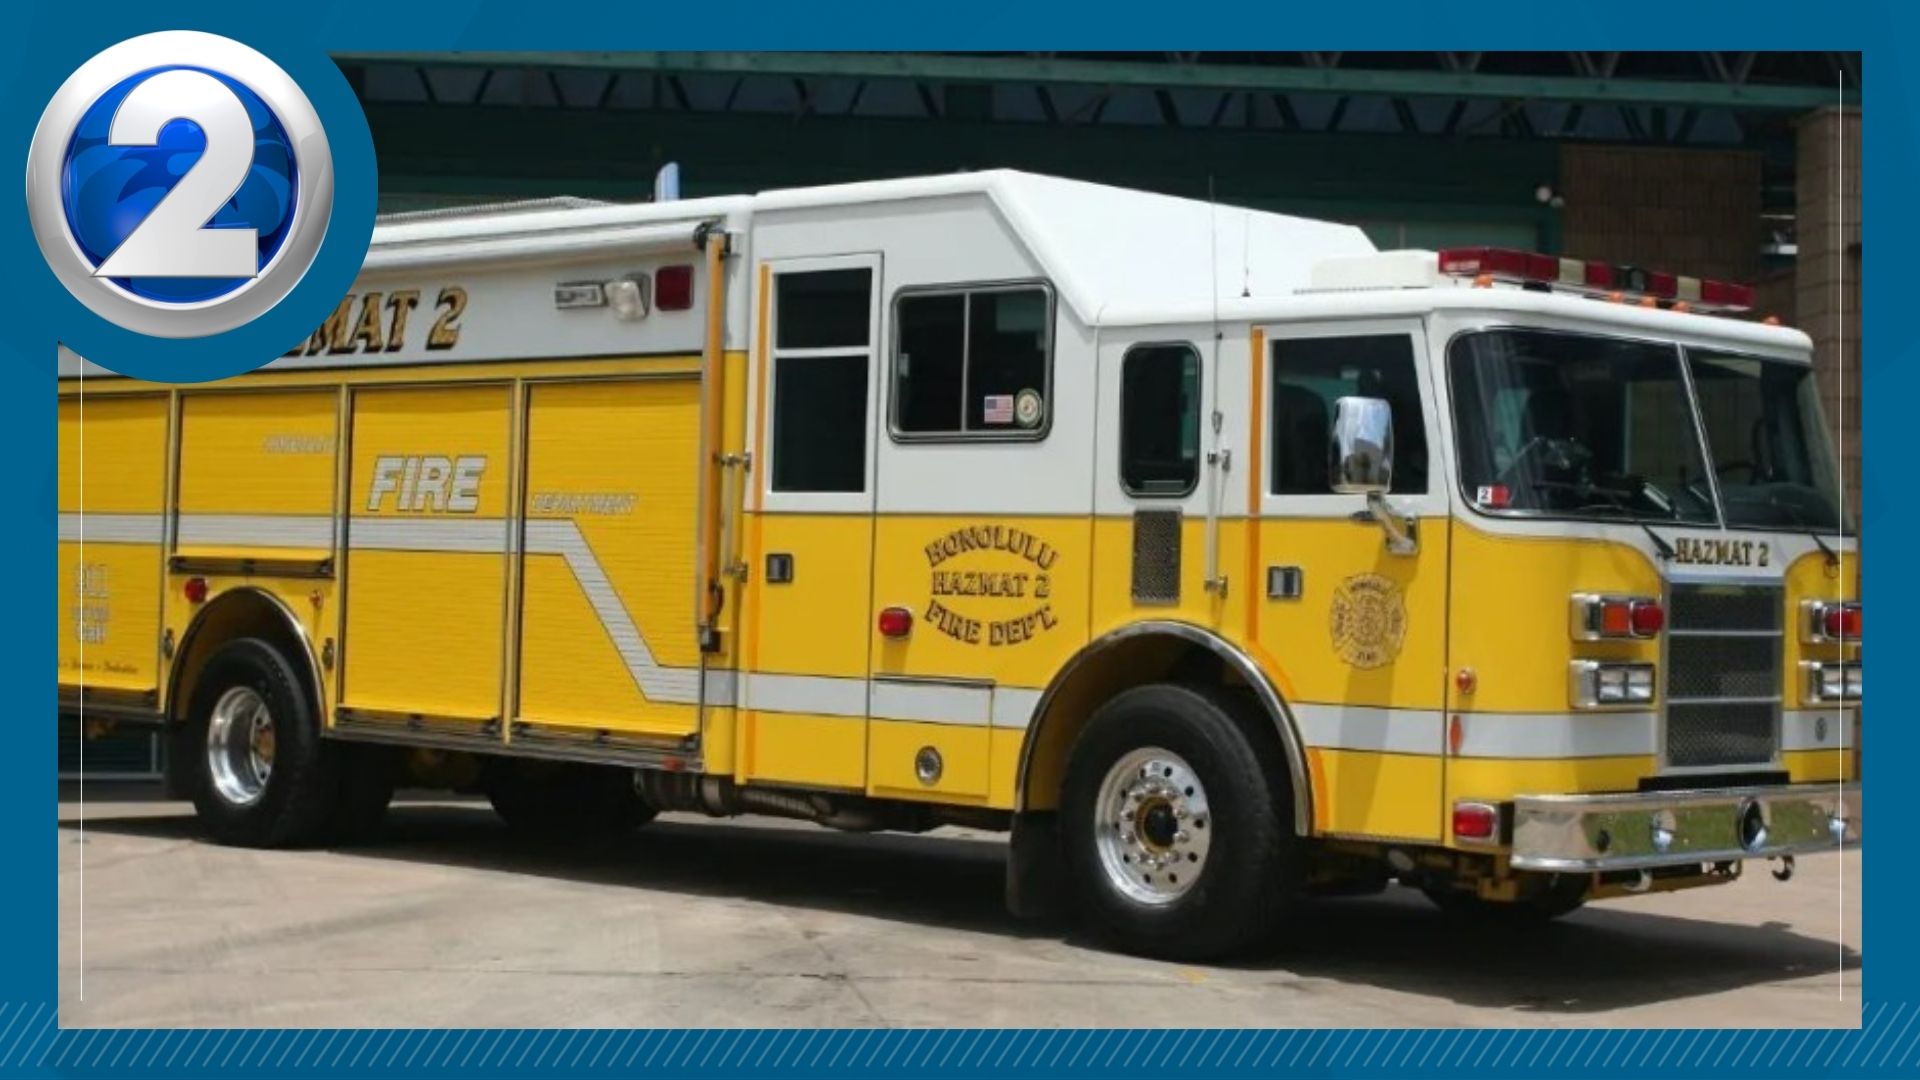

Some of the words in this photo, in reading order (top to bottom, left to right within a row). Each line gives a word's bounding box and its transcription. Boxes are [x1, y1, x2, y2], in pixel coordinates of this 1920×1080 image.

[281, 289, 420, 357] MAT
[426, 285, 468, 350] 2
[366, 455, 487, 512] FIRE
[924, 525, 1058, 570] HONOLULU
[1676, 537, 1753, 566] HAZMAT
[1757, 541, 1769, 567] 2
[932, 571, 1028, 597] HAZMAT
[1034, 573, 1050, 598] 2
[924, 600, 981, 644] FIRE
